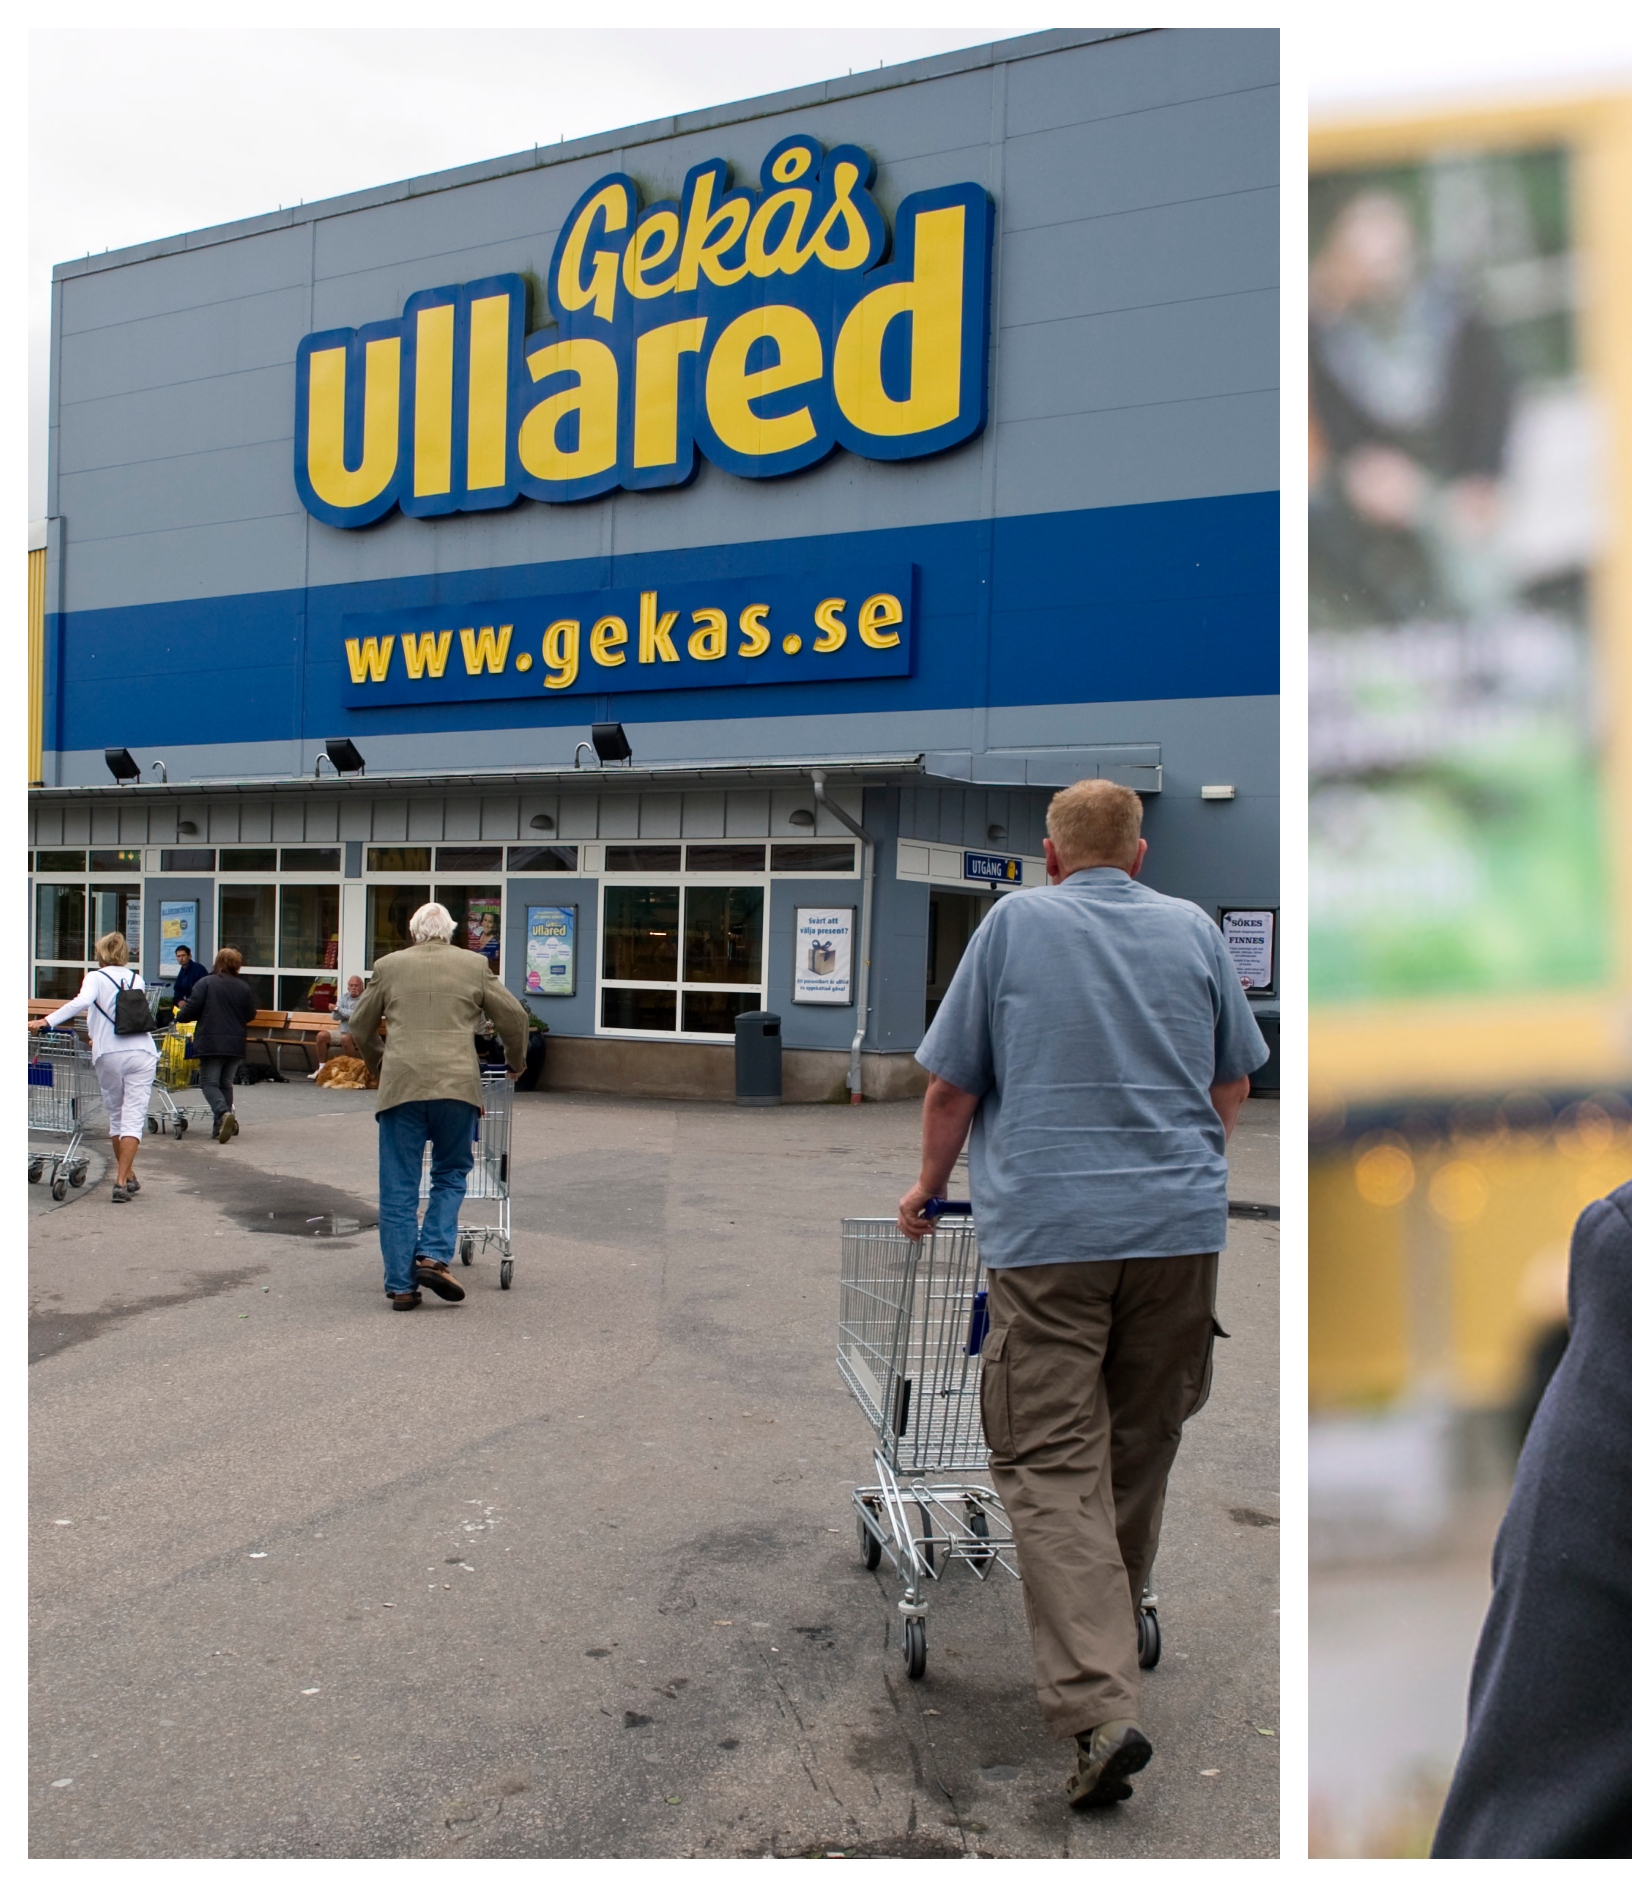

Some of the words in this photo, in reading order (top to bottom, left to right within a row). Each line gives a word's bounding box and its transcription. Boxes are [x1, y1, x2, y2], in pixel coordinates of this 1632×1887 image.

[557, 145, 871, 323] Gekås
[307, 204, 967, 508] Ullared
[344, 590, 904, 690] www.gekas.se
[972, 857, 1002, 877] UTGÅNG
[808, 917, 826, 925] Svårt
[827, 917, 839, 925] att
[1231, 918, 1263, 927] SÖKES
[532, 925, 567, 936] Ullared
[800, 927, 816, 935] välja
[817, 927, 849, 935] present?
